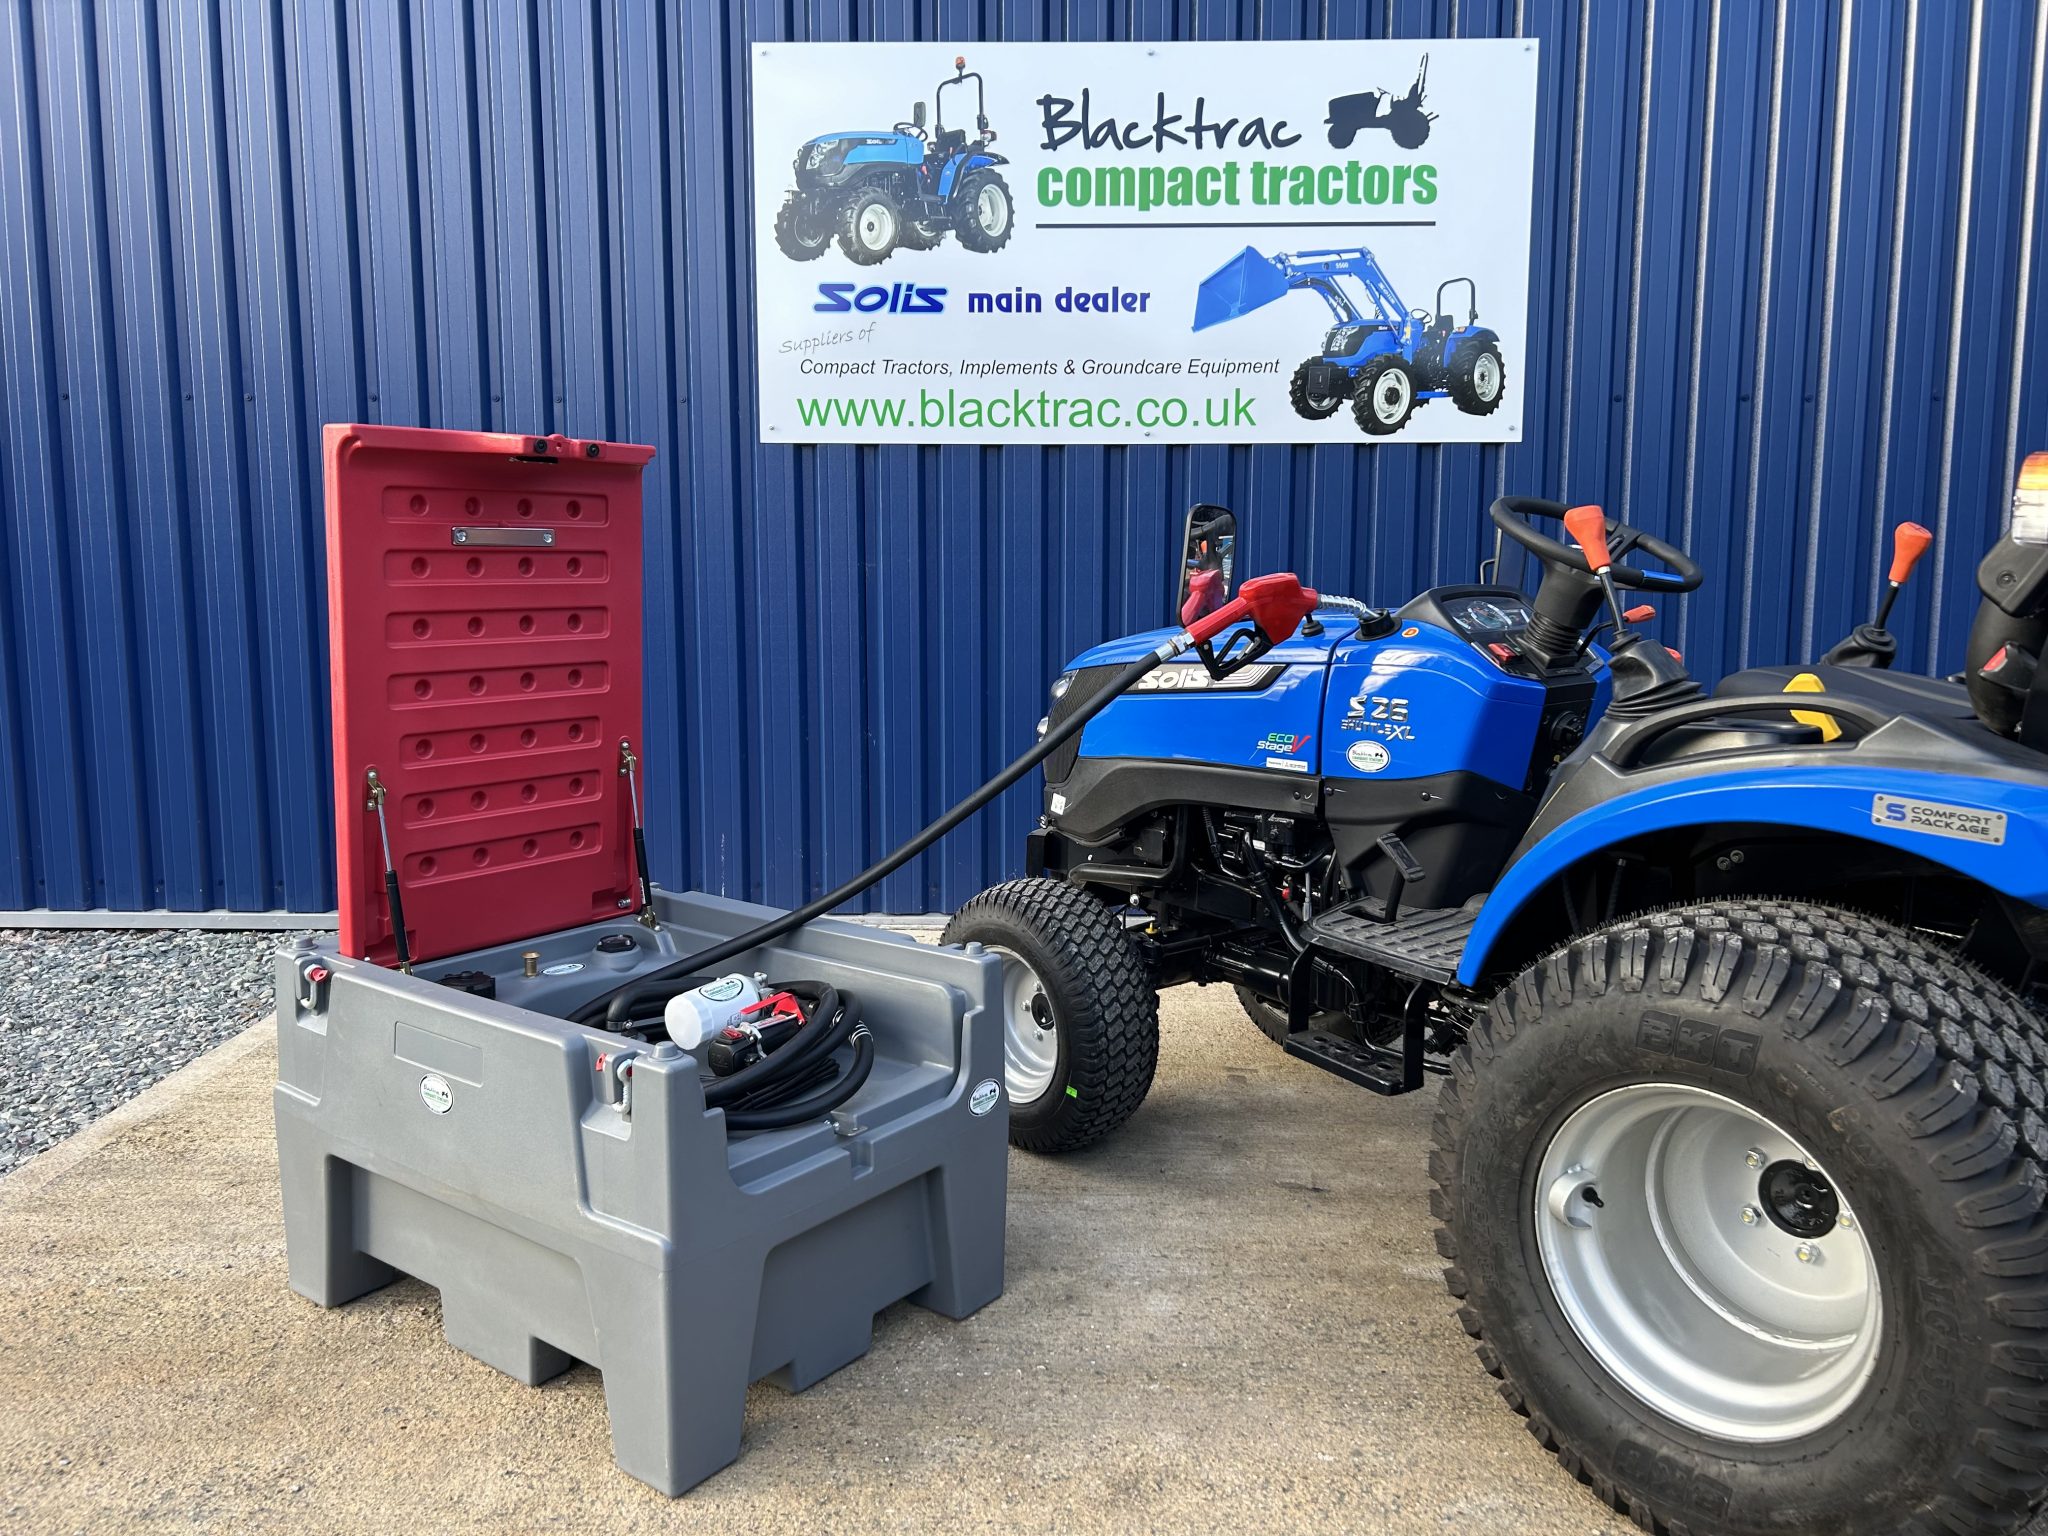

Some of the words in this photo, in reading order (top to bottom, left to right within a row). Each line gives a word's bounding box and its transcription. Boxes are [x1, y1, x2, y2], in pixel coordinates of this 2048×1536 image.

[1036, 88, 1302, 153] Blacktrac
[1038, 162, 1240, 211] compact
[1250, 161, 1437, 206] tractors
[969, 287, 1041, 313] main
[1055, 286, 1150, 313] dealer
[779, 331, 854, 356] Suppliers
[859, 322, 877, 343] of
[800, 358, 876, 378] Compact
[882, 359, 953, 377] Tractors,
[960, 359, 1057, 378] Implements
[1064, 359, 1076, 375] &
[1082, 358, 1181, 375] Groundcare
[1187, 358, 1280, 378] Equipment
[797, 388, 1257, 428] www.blacktrac.co.uk
[1257, 740, 1293, 753] Stage
[1268, 733, 1295, 743] ECO
[1911, 806, 1992, 826] COMFORT
[1911, 815, 1991, 836] PACKAGE
